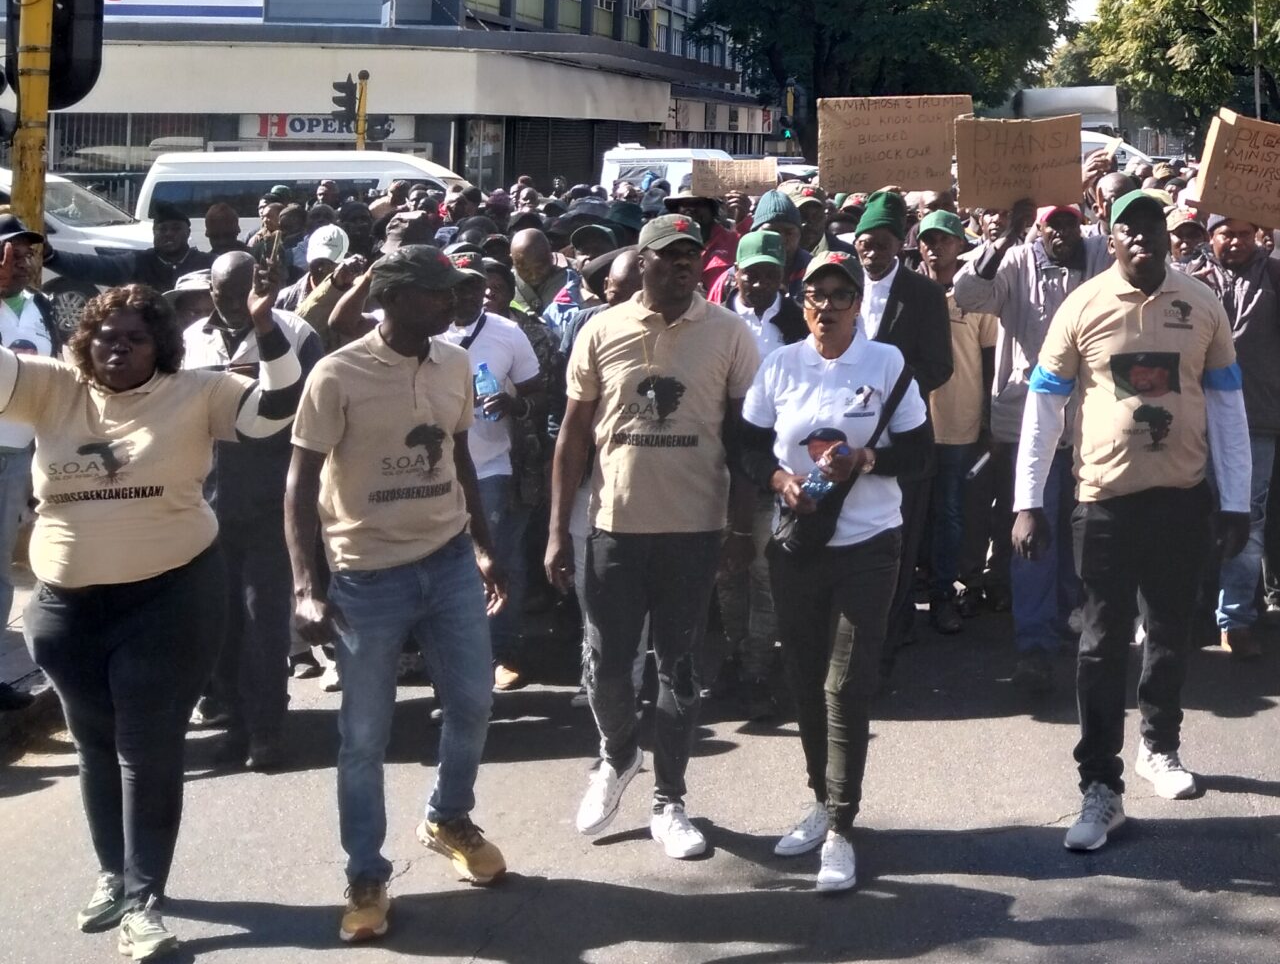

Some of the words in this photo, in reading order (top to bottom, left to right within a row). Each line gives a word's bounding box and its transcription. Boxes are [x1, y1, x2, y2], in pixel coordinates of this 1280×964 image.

[257, 113, 395, 137] HOPERE
[843, 116, 870, 129] YOU
[973, 123, 1069, 158] PHANSI
[48, 461, 100, 475] S.O.A
[382, 454, 426, 470] S.O.A
